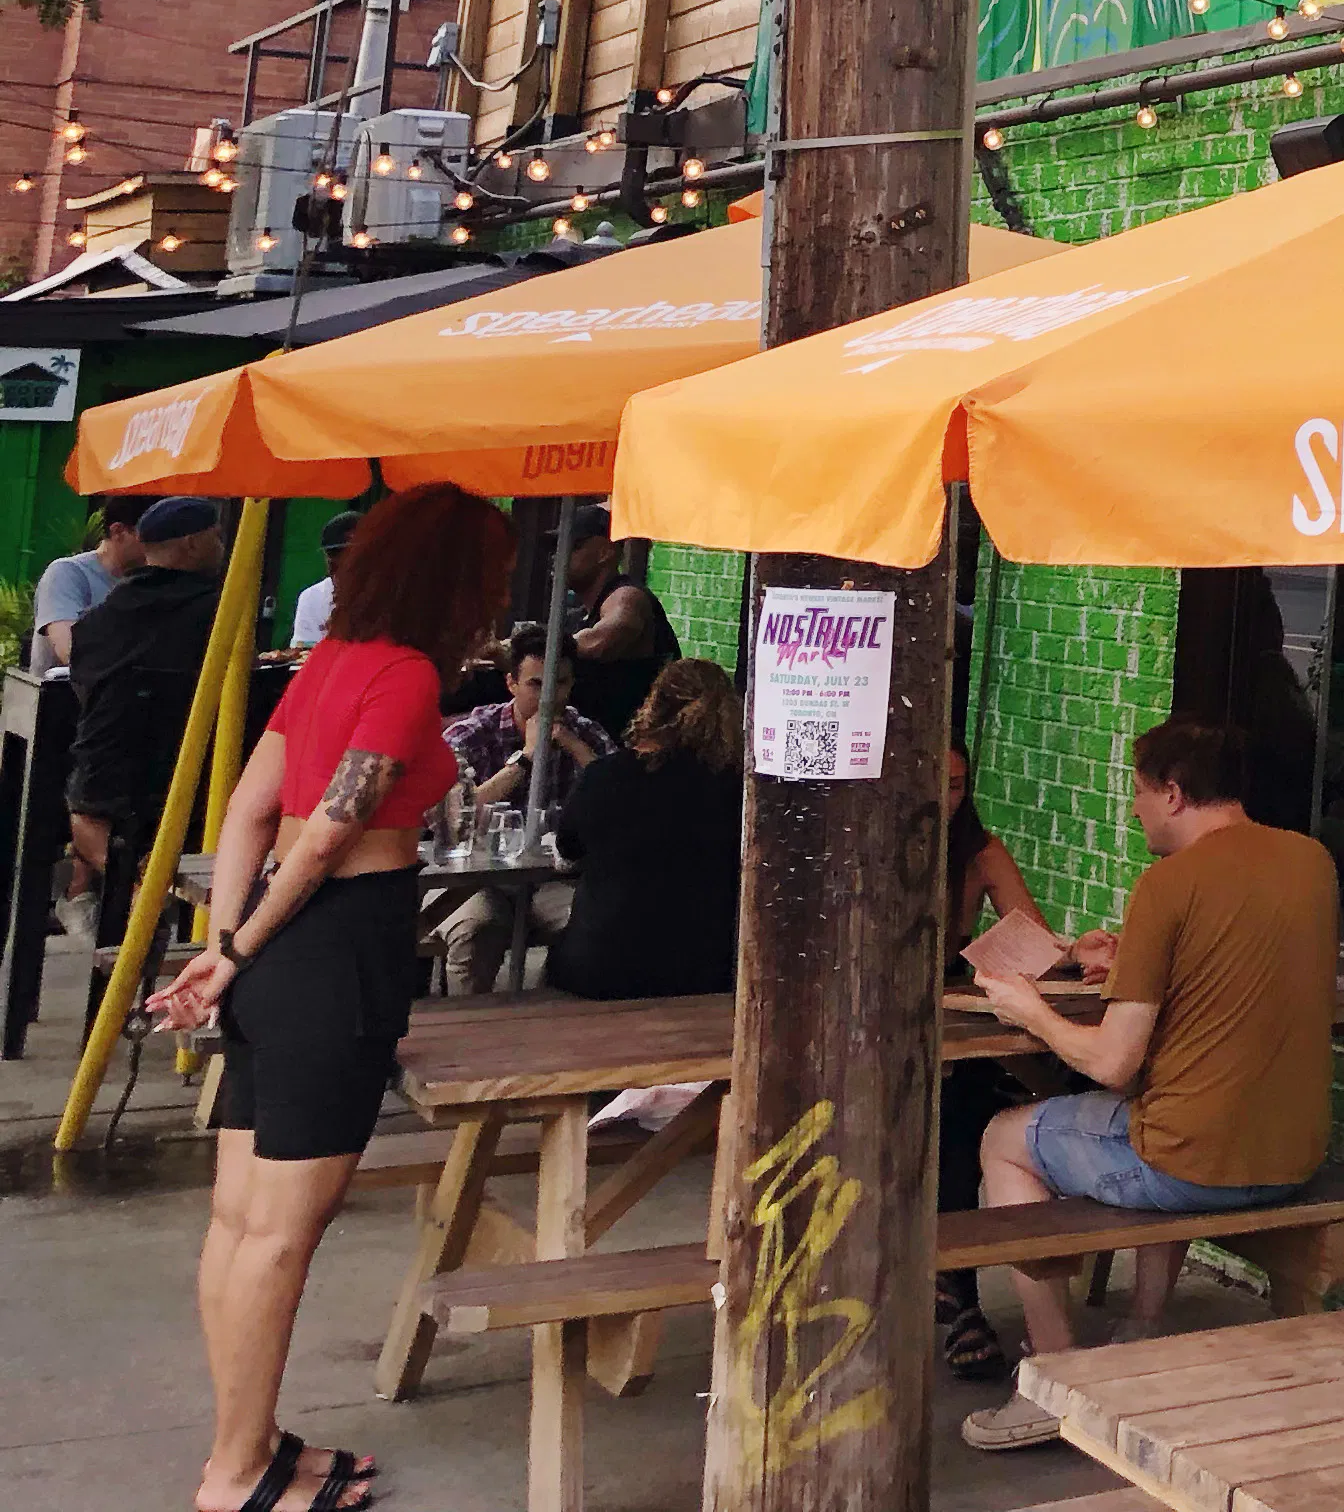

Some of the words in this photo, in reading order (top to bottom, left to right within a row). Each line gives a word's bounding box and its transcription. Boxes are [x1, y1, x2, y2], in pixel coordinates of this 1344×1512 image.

[769, 672, 821, 688] SATURDAY,
[824, 675, 851, 687] JULY
[853, 675, 869, 687] 23
